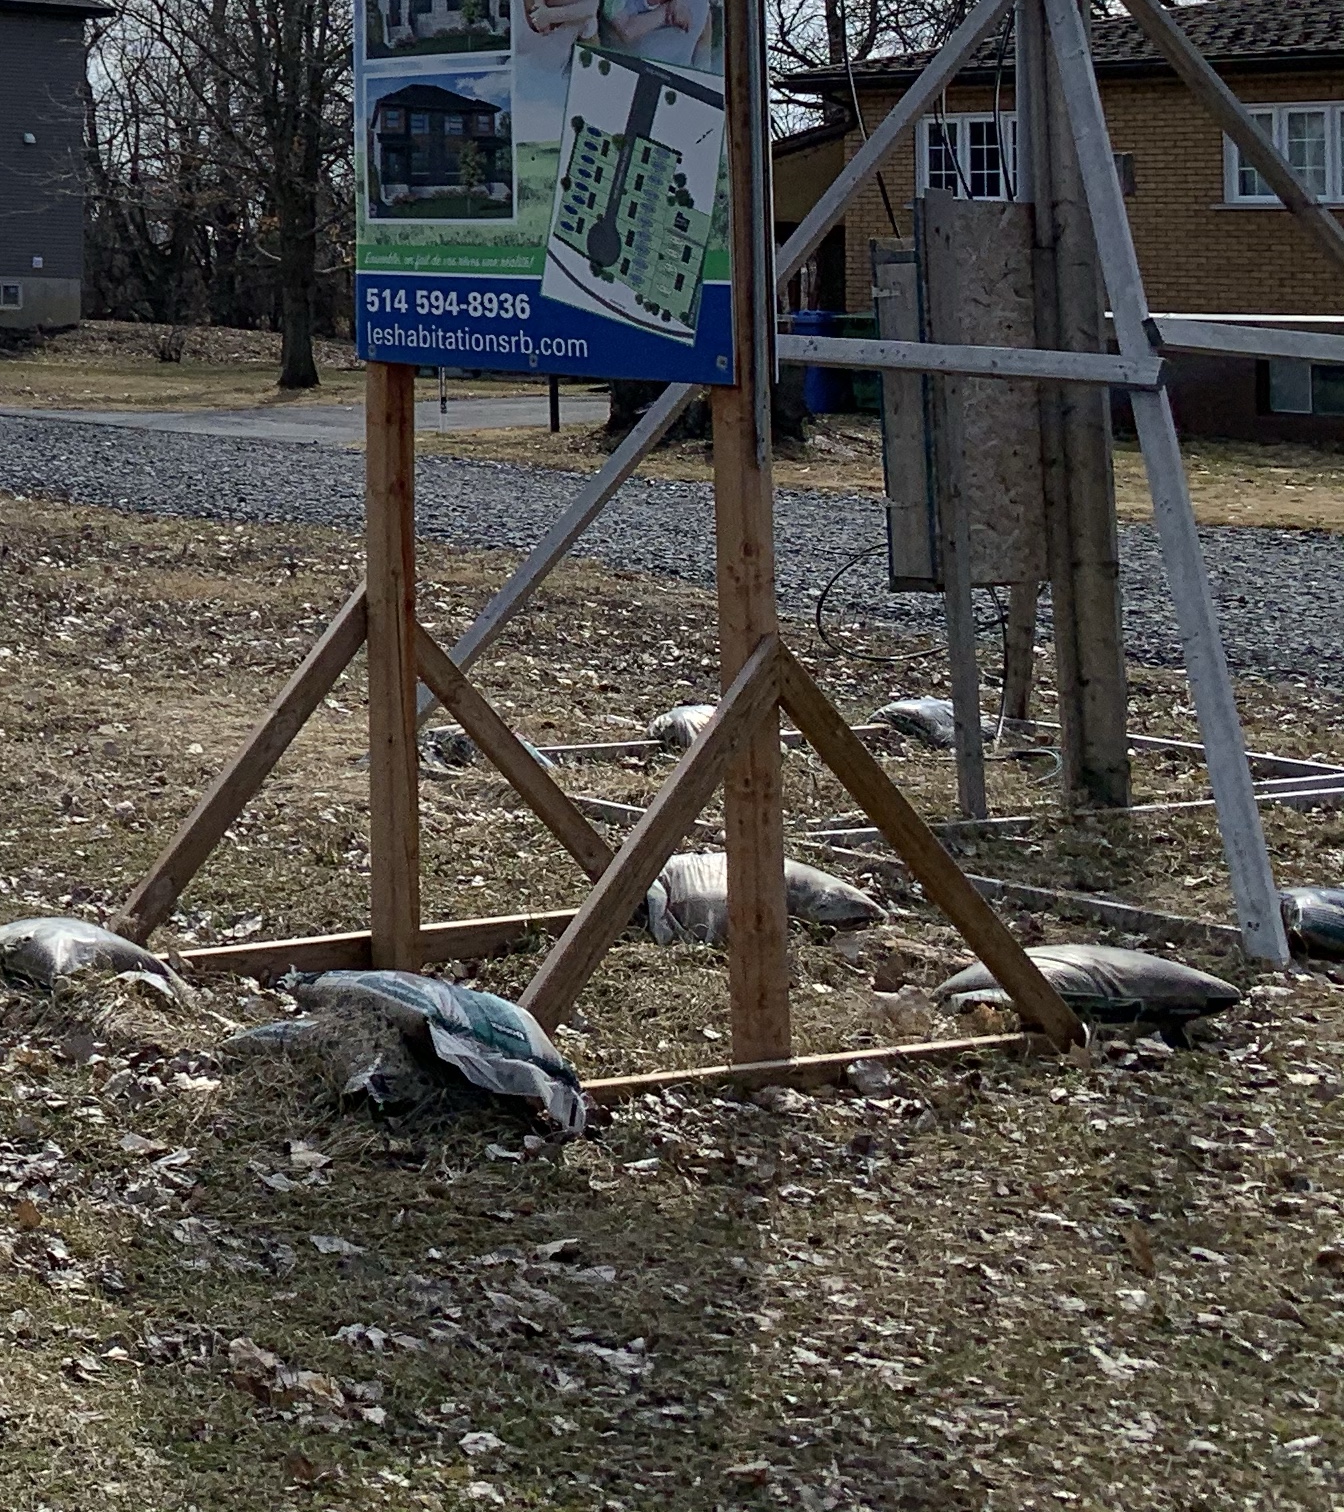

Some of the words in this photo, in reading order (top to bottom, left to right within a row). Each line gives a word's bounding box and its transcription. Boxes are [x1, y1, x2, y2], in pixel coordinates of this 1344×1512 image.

[366, 288, 409, 314] 514
[415, 289, 531, 320] 594-8936
[367, 321, 589, 358] leshabitationsrb.com
